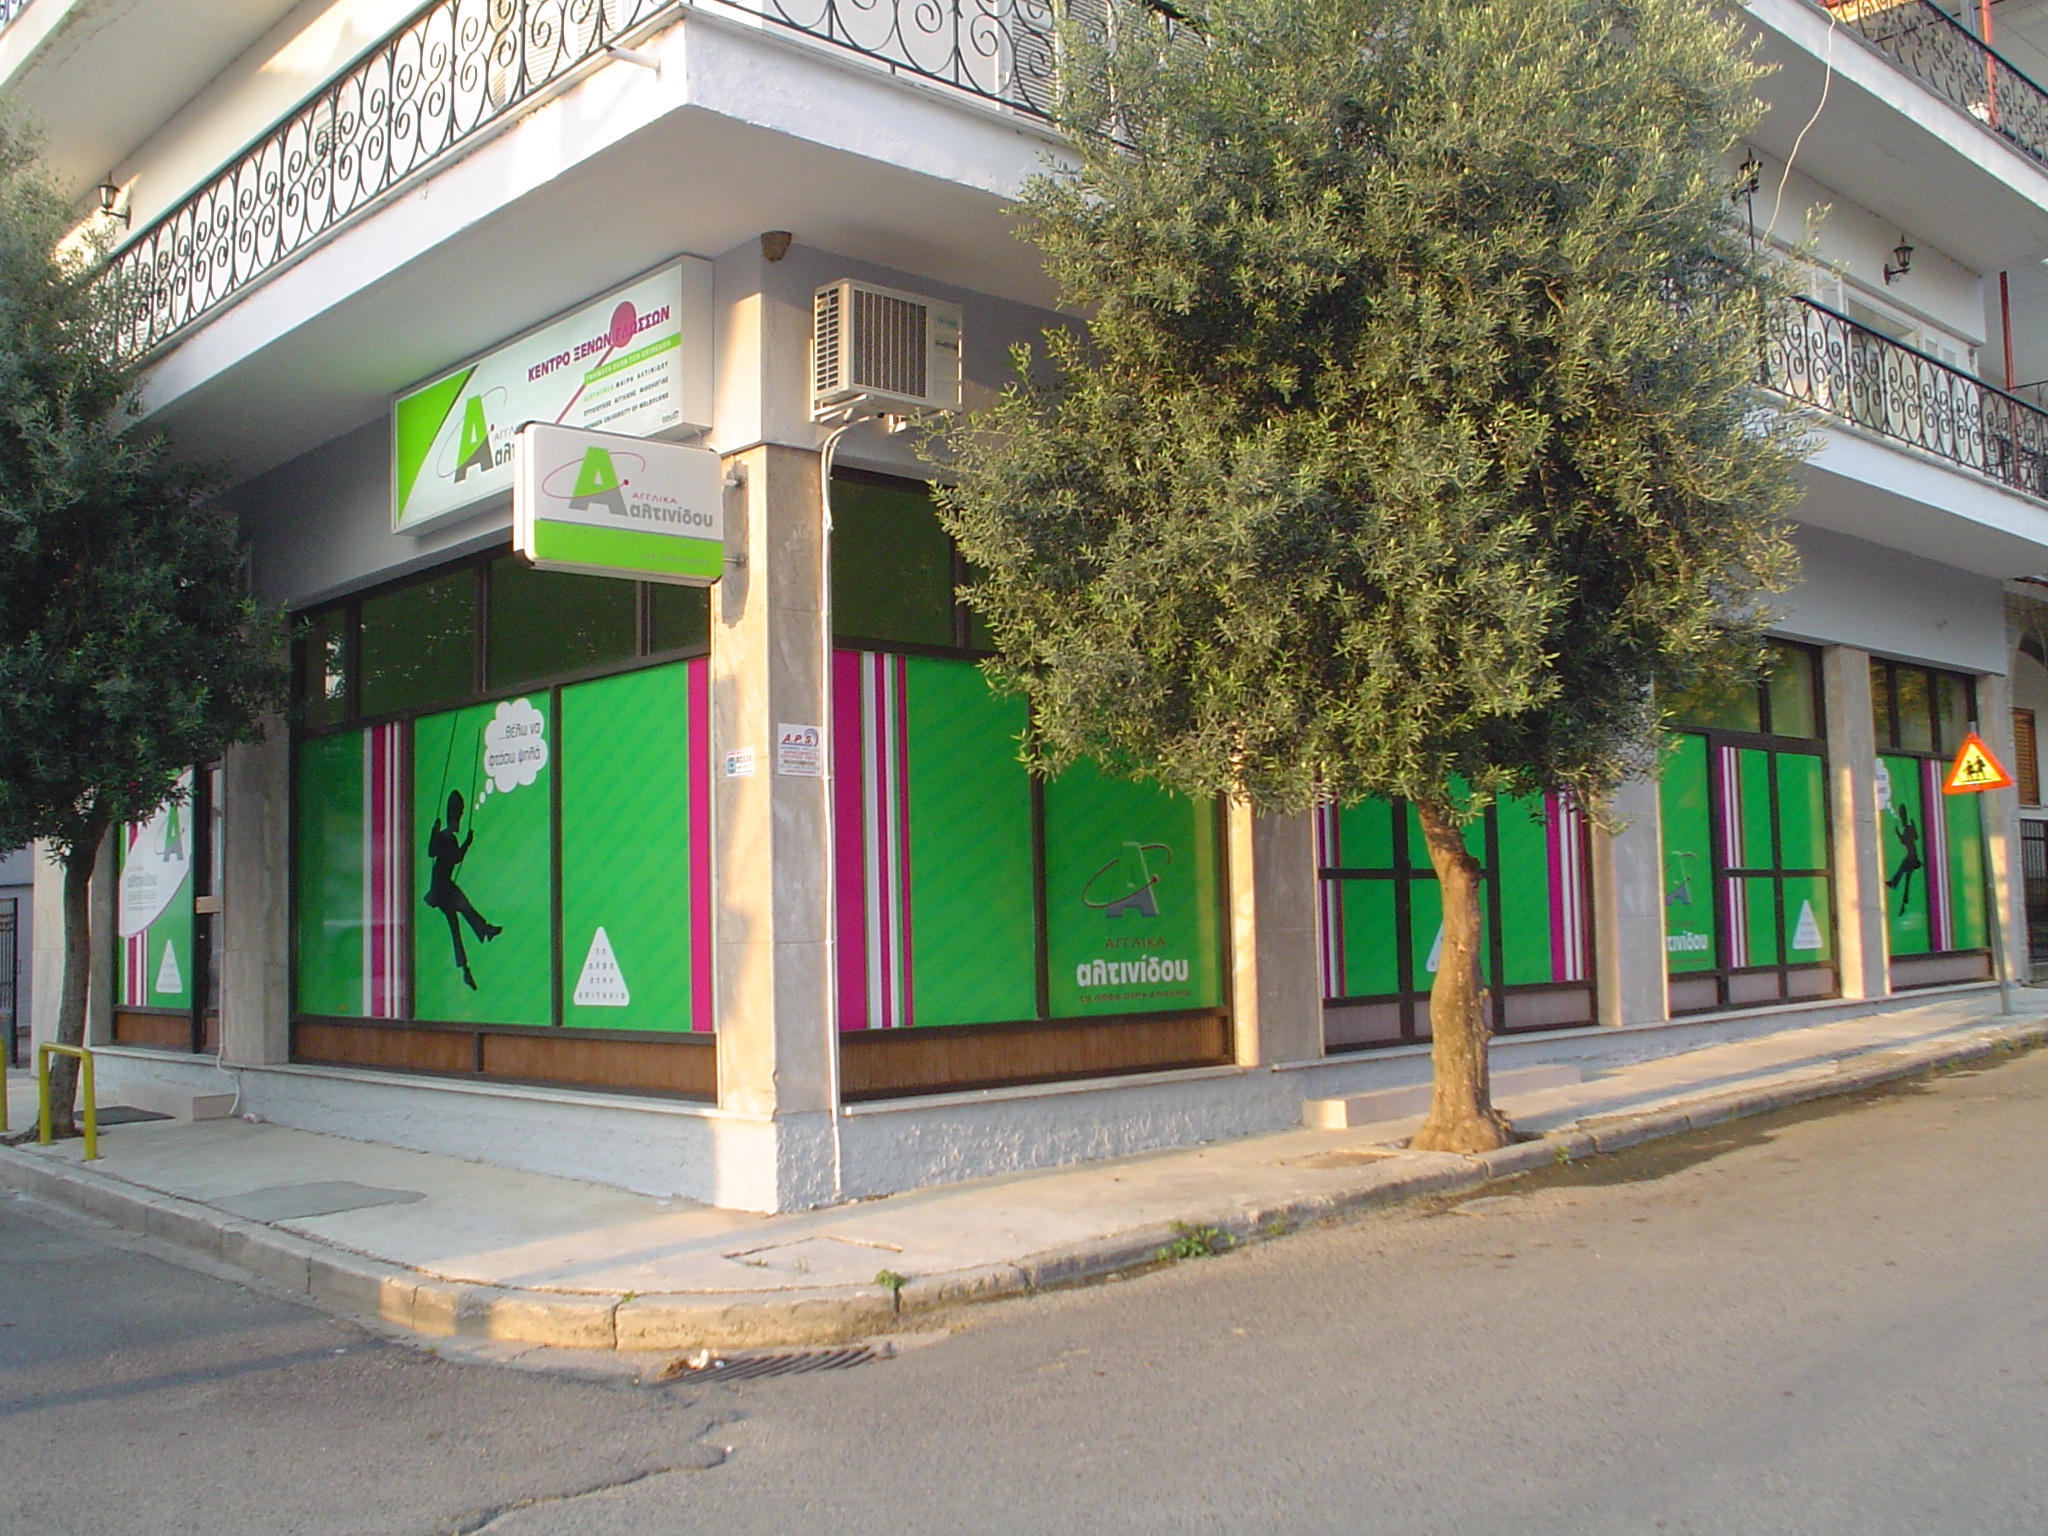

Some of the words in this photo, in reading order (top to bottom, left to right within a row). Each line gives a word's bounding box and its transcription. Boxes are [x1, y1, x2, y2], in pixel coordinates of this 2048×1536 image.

[528, 351, 570, 382] ΚΕΝΤΡΟ
[574, 331, 613, 362] ΞΕΝΩΝ
[615, 305, 670, 341] ΓΛΩΣΣΩΝ
[632, 492, 677, 504] ΑΓΓΛΙΚΑ
[630, 503, 713, 527] αλτινίδου
[530, 722, 540, 734] να
[489, 750, 516, 769] φτάσω
[518, 744, 541, 765] ψηλά
[1104, 936, 1166, 949] ΑΓΓΛΙΚΑ
[1076, 954, 1189, 988] αλτινίδου
